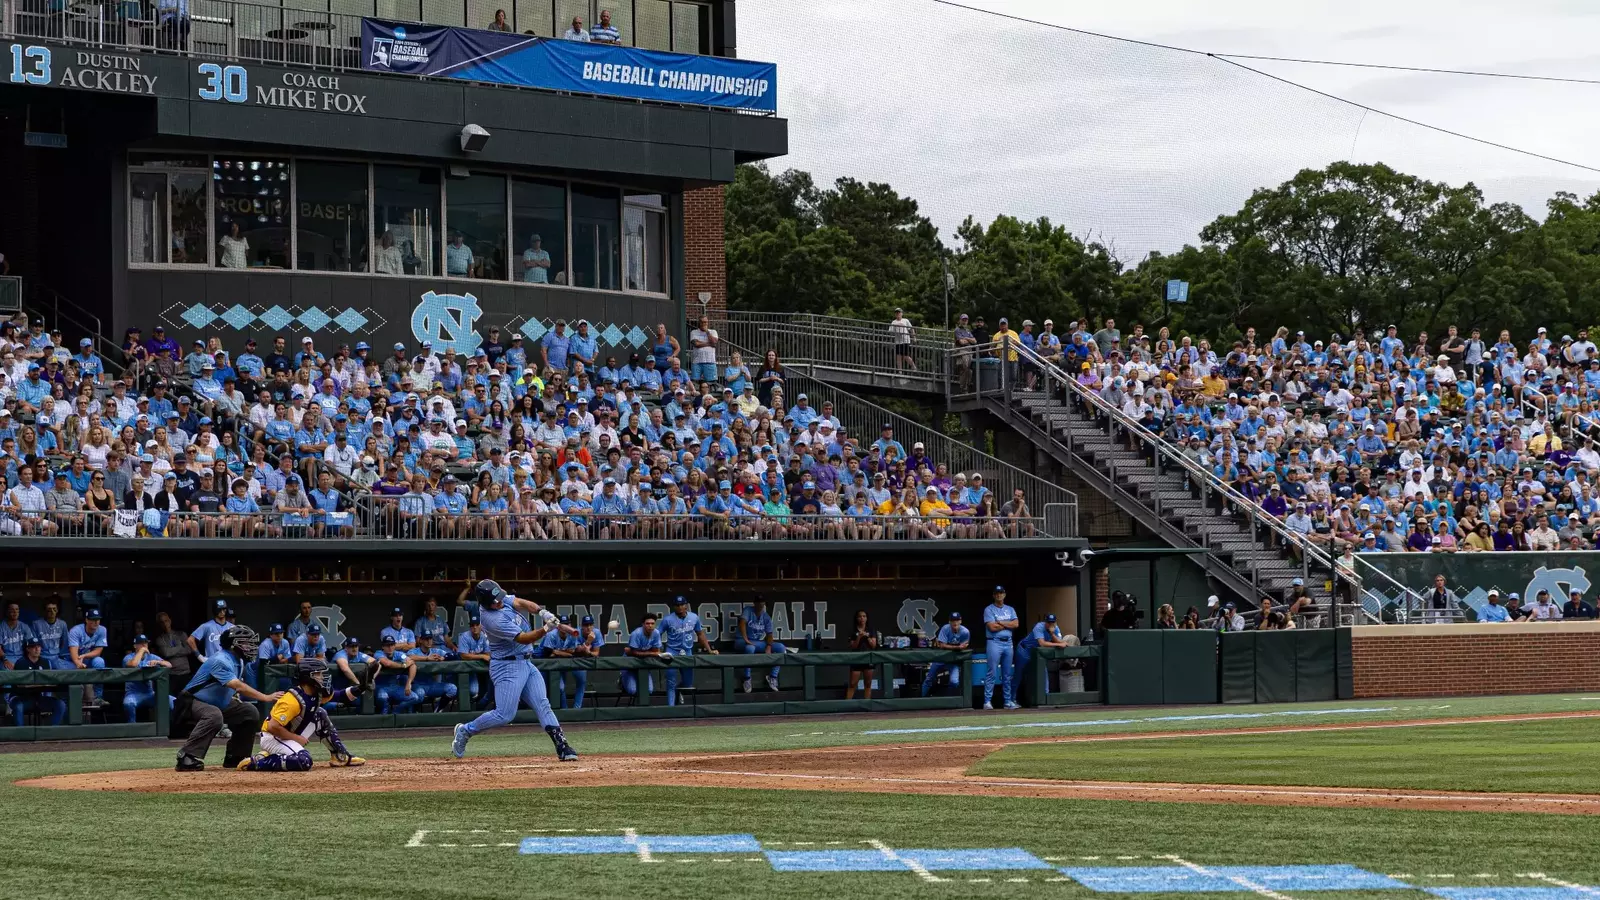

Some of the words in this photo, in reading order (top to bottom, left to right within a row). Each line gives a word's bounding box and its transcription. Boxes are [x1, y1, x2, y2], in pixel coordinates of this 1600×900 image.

[10, 43, 51, 85] 13
[76, 51, 141, 71] DUSTIN
[393, 44, 428, 57] BASEBALL
[59, 67, 158, 95] ACKLEY
[198, 63, 248, 103] 30
[282, 72, 340, 91] COACH
[582, 60, 655, 87] BASEBALL
[658, 69, 769, 98] CHAMPIONSHIP
[255, 85, 317, 110] MIKE
[322, 91, 367, 114] FOX
